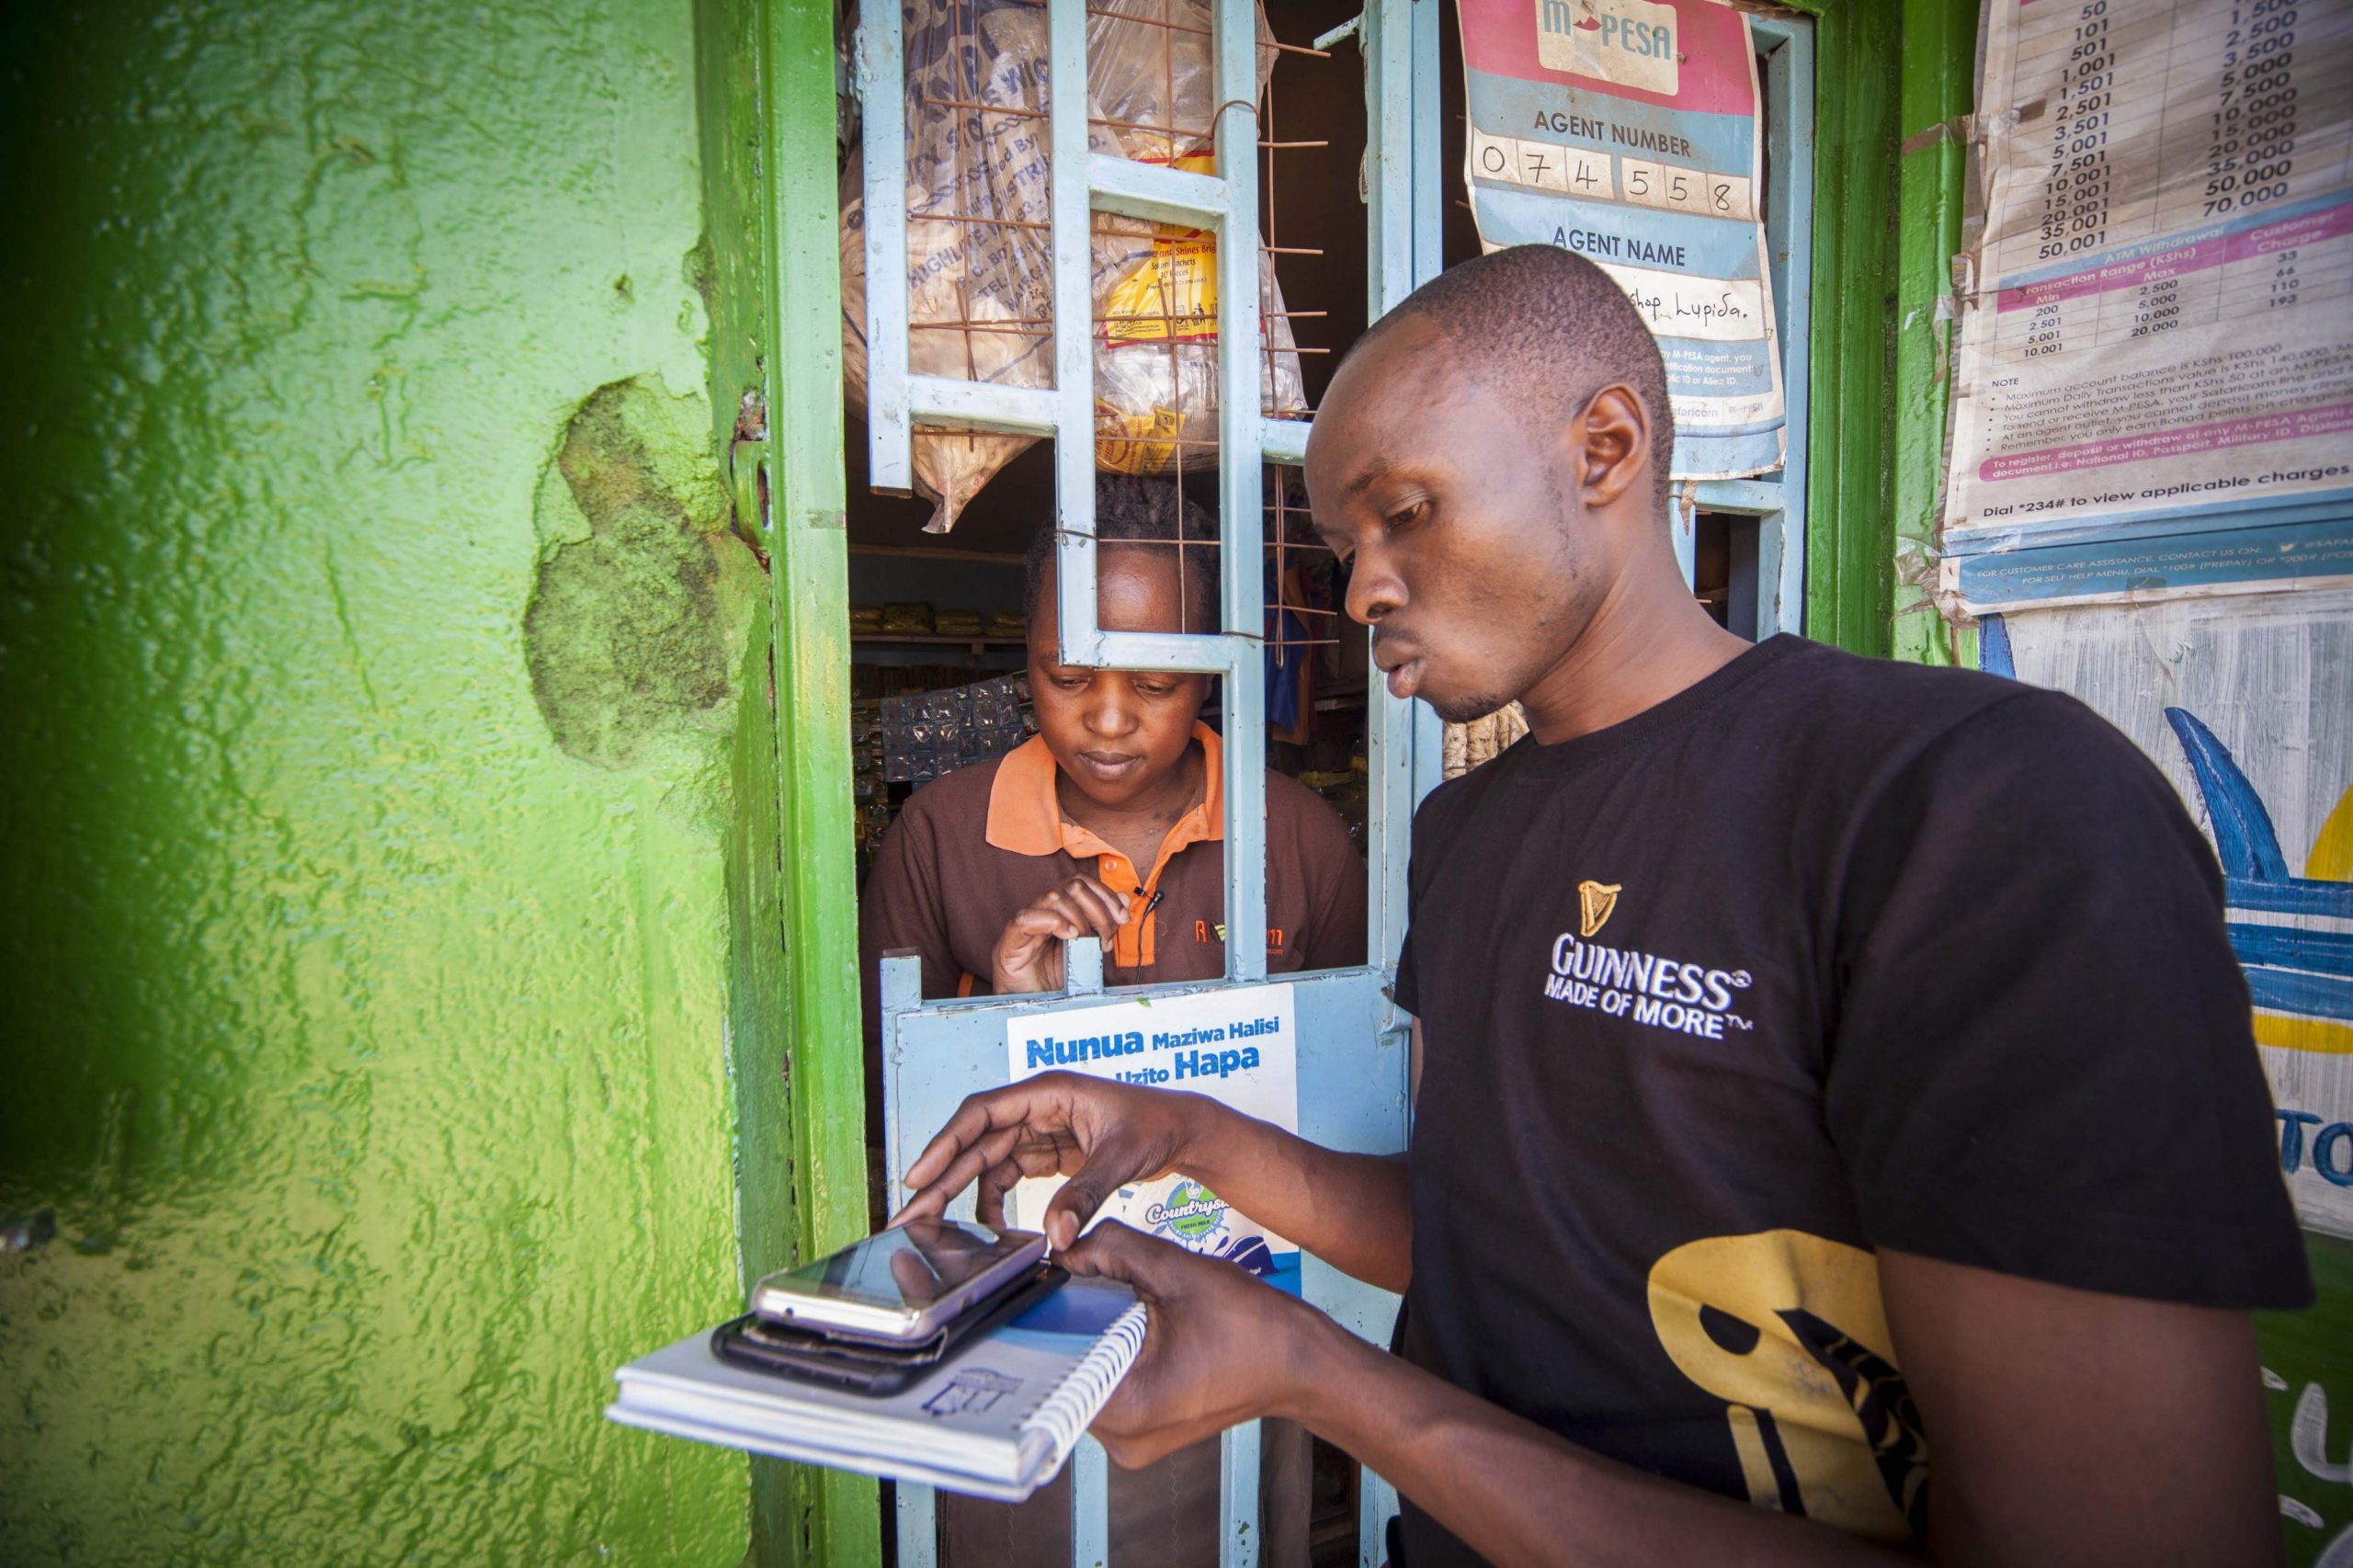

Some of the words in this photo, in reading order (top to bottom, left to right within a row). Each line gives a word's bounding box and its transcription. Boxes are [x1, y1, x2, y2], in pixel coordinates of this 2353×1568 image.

[2081, 1, 2107, 19] 50
[2075, 18, 2109, 41] 101
[2226, 10, 2297, 47] 2,500
[2071, 38, 2107, 61] 501
[2222, 32, 2294, 68] 3,500
[2063, 52, 2115, 83] 1,001
[2221, 52, 2292, 87] 5,000
[2061, 72, 2113, 101] 1,501
[2219, 72, 2290, 107] 7,500
[2056, 93, 2111, 121] 2,501
[2211, 105, 2296, 141] 15,000
[2212, 88, 2297, 125] 10,000
[1534, 110, 1604, 141] AGENT
[1611, 123, 1691, 157] NUMBER
[2054, 112, 2109, 141] 3,501
[2210, 122, 2296, 159] 20,000
[2052, 131, 2108, 160] 5,001
[2207, 140, 2294, 176] 35,000
[2046, 165, 2111, 195] 10,001
[2052, 151, 2106, 177] 7,501
[2204, 160, 2291, 197] 50,000
[2044, 181, 2109, 210] 15,001
[2203, 182, 2289, 217] 70,000
[2040, 211, 2108, 240] 35,001
[1552, 226, 1620, 256] AGENT
[1627, 239, 1685, 267] NAME
[2038, 231, 2106, 260] 50,001
[2104, 249, 2134, 265] ATM
[2138, 226, 2224, 255] Withdrawal
[2025, 274, 2096, 295] ransaction
[2100, 262, 2145, 279] Range
[2143, 267, 2177, 282] Max
[2036, 294, 2059, 305] Min
[2036, 305, 2059, 317] 200
[2269, 294, 2297, 308] 193
[1673, 350, 1703, 361] M-PESA
[1733, 354, 1752, 362] you
[1992, 378, 2019, 387] NOTE
[2005, 398, 2060, 413] Maximum
[2064, 389, 2091, 403] Daily
[2097, 376, 2175, 395] Transactions
[2178, 368, 2217, 381] value
[2006, 387, 2062, 402] Maximum
[2064, 375, 2117, 392] account
[2120, 365, 2177, 382] balance
[2002, 434, 2016, 442] At
[2036, 425, 2072, 437] agent
[2117, 414, 2141, 427] you
[2144, 404, 2193, 419] cannot
[2198, 395, 2251, 412] deposit
[2004, 411, 2028, 423] You
[2031, 405, 2069, 418] cannot
[2073, 394, 2130, 413] withdraw
[2133, 389, 2155, 399] less
[2160, 383, 2190, 394] than
[2018, 419, 2045, 430] send
[2048, 416, 2059, 425] or
[2063, 409, 2109, 423] receive
[2201, 379, 2276, 398] Safaricom
[2069, 432, 2093, 444] you
[2095, 425, 2121, 440] only
[2125, 420, 2155, 431] earn
[2208, 404, 2251, 421] points
[1993, 464, 2054, 479] document
[2076, 452, 2129, 466] National
[2217, 432, 2269, 446] Military
[1994, 460, 2006, 469] To
[2058, 446, 2103, 460] deposit
[2107, 444, 2120, 452] or
[2122, 433, 2182, 450] withdraw
[1984, 506, 2013, 517] Dial
[2071, 497, 2086, 506] to
[2093, 491, 2135, 504] view
[2141, 476, 2250, 499] applicable
[1977, 570, 1997, 578] FOR
[1999, 564, 2054, 576] CUSTOMER
[2057, 561, 2086, 571] CARE
[2158, 551, 2217, 562] CONTACT
[2022, 575, 2043, 585] FOR
[2045, 574, 2066, 583] SELF
[2068, 571, 2094, 581] HELP
[2133, 566, 2160, 574] DIAL
[1552, 932, 1733, 1011] GUINNESS
[1544, 973, 1599, 1008] MADE
[1600, 989, 1632, 1017] OF
[1632, 994, 1724, 1040] MORE
[1027, 1030, 1145, 1069] Nunua
[1152, 1028, 1225, 1051] Maziwa
[1229, 1017, 1280, 1040] Halisi
[1175, 1047, 1260, 1079] Hapa
